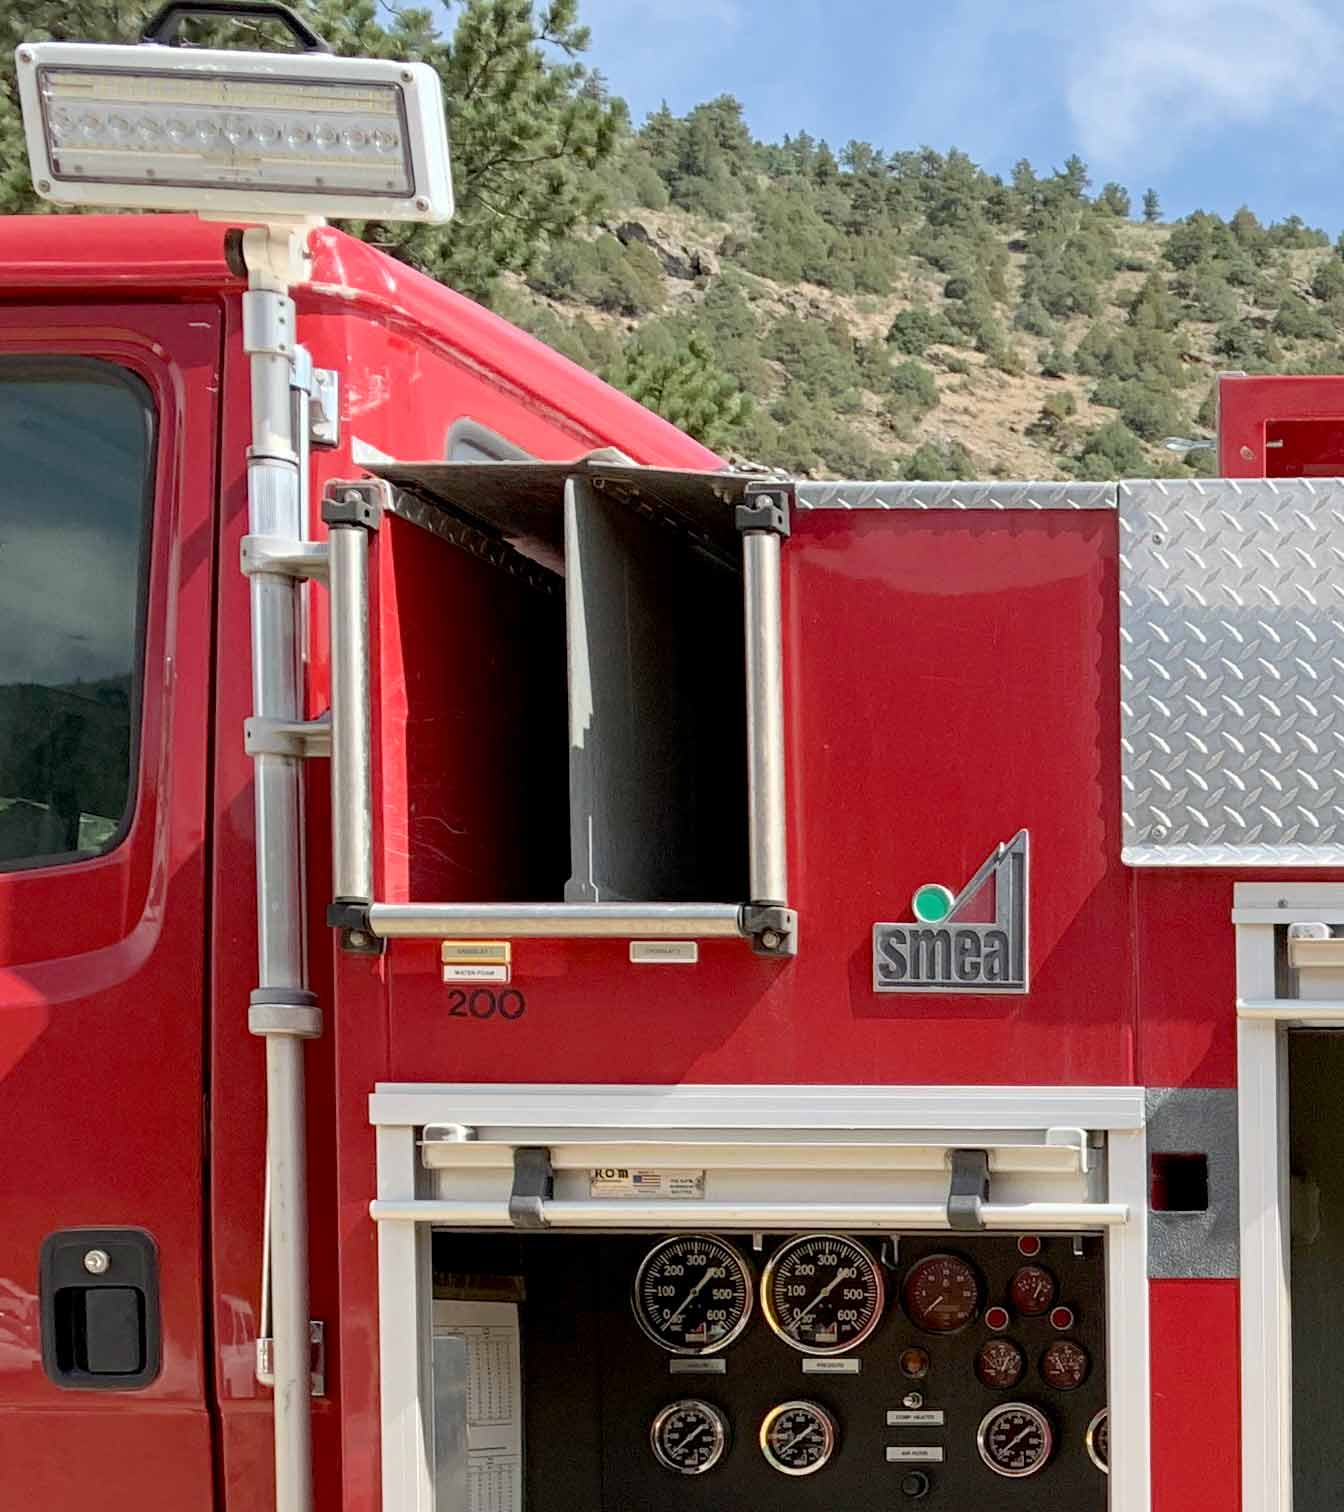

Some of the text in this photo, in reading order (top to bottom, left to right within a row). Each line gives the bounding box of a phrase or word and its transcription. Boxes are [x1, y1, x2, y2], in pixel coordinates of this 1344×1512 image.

[877, 900, 1025, 982] smeal
[447, 988, 526, 1020] 200
[686, 1255, 706, 1266] 300
[817, 1255, 837, 1266] 300
[664, 1265, 684, 1276] 200
[795, 1265, 815, 1276] 200
[657, 1285, 675, 1297] 100
[713, 1289, 732, 1300] 500
[787, 1285, 806, 1297] 100
[843, 1289, 863, 1300] 500
[707, 1309, 726, 1320] 600
[837, 1309, 857, 1321] 600
